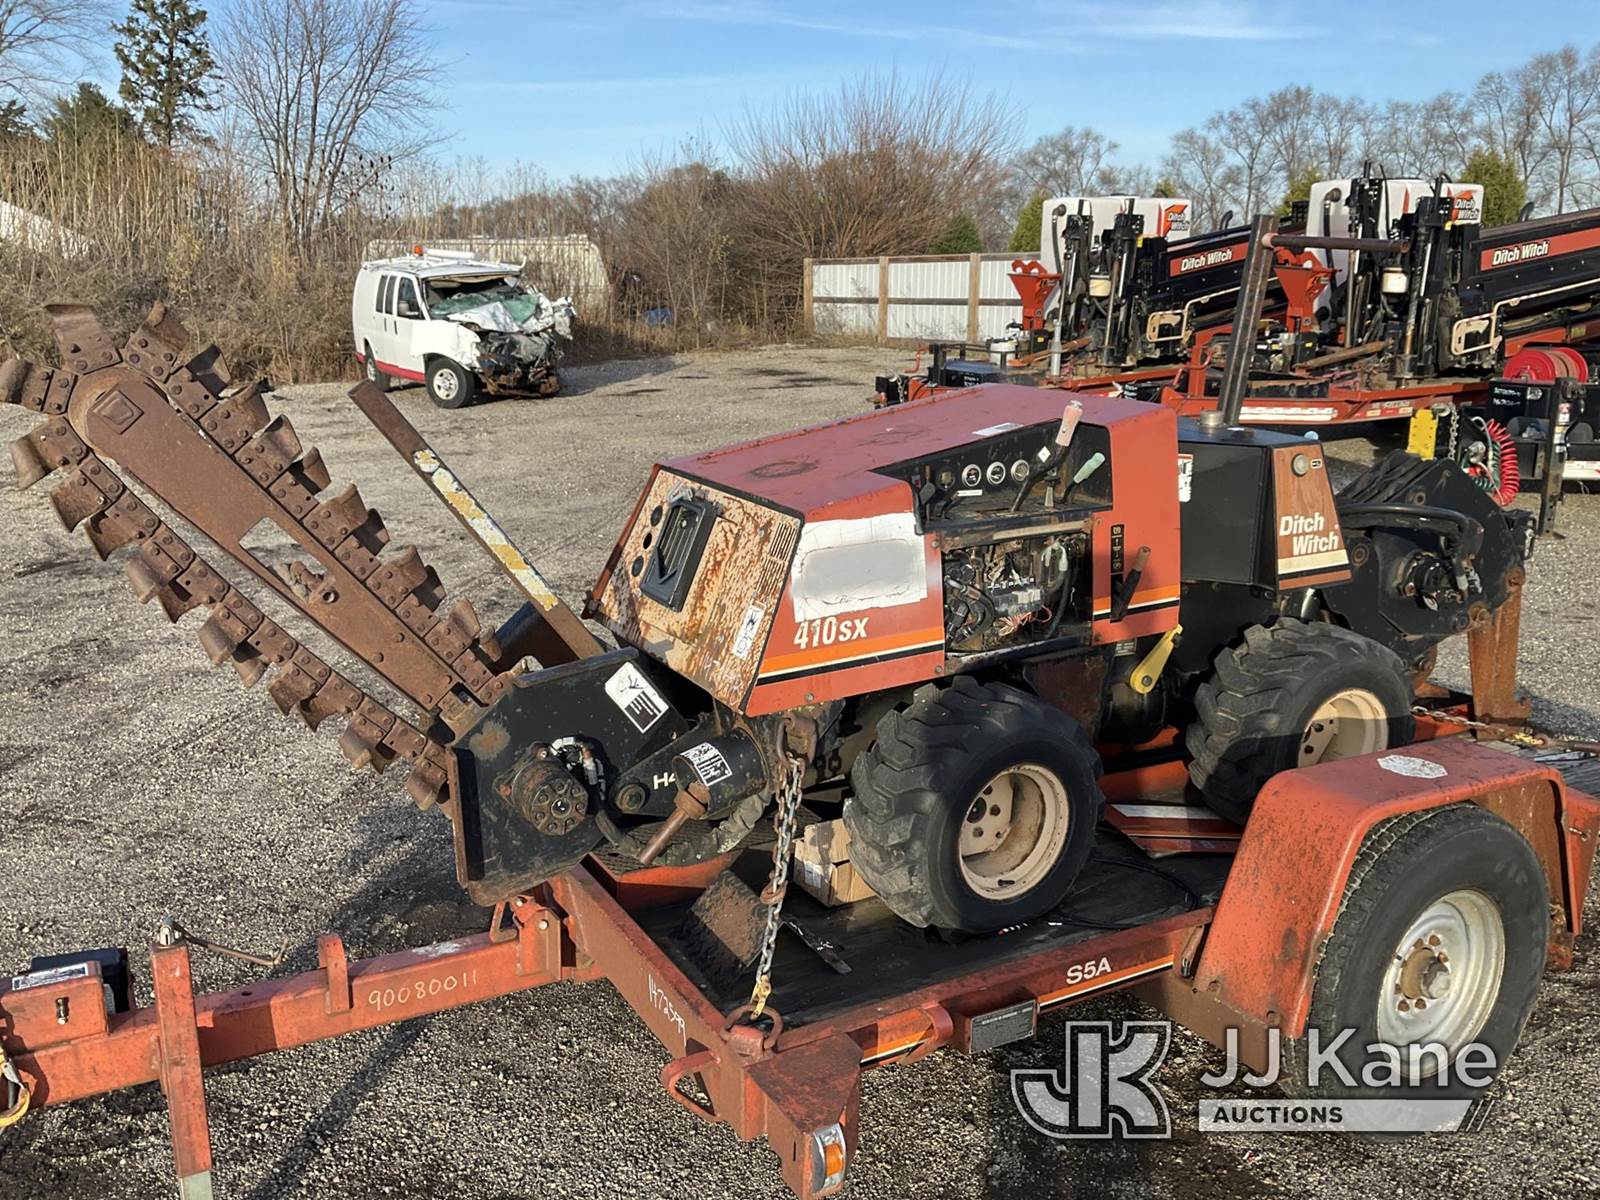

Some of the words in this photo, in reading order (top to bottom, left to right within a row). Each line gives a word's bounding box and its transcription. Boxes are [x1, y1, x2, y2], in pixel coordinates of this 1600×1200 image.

[1181, 256, 1206, 271] Ditch
[1207, 249, 1233, 264] Witch
[1492, 247, 1519, 266] Ditch
[1521, 240, 1549, 259] Witch
[1279, 512, 1325, 536] Ditch
[1292, 532, 1340, 556] Witch
[1066, 956, 1112, 985] S5A
